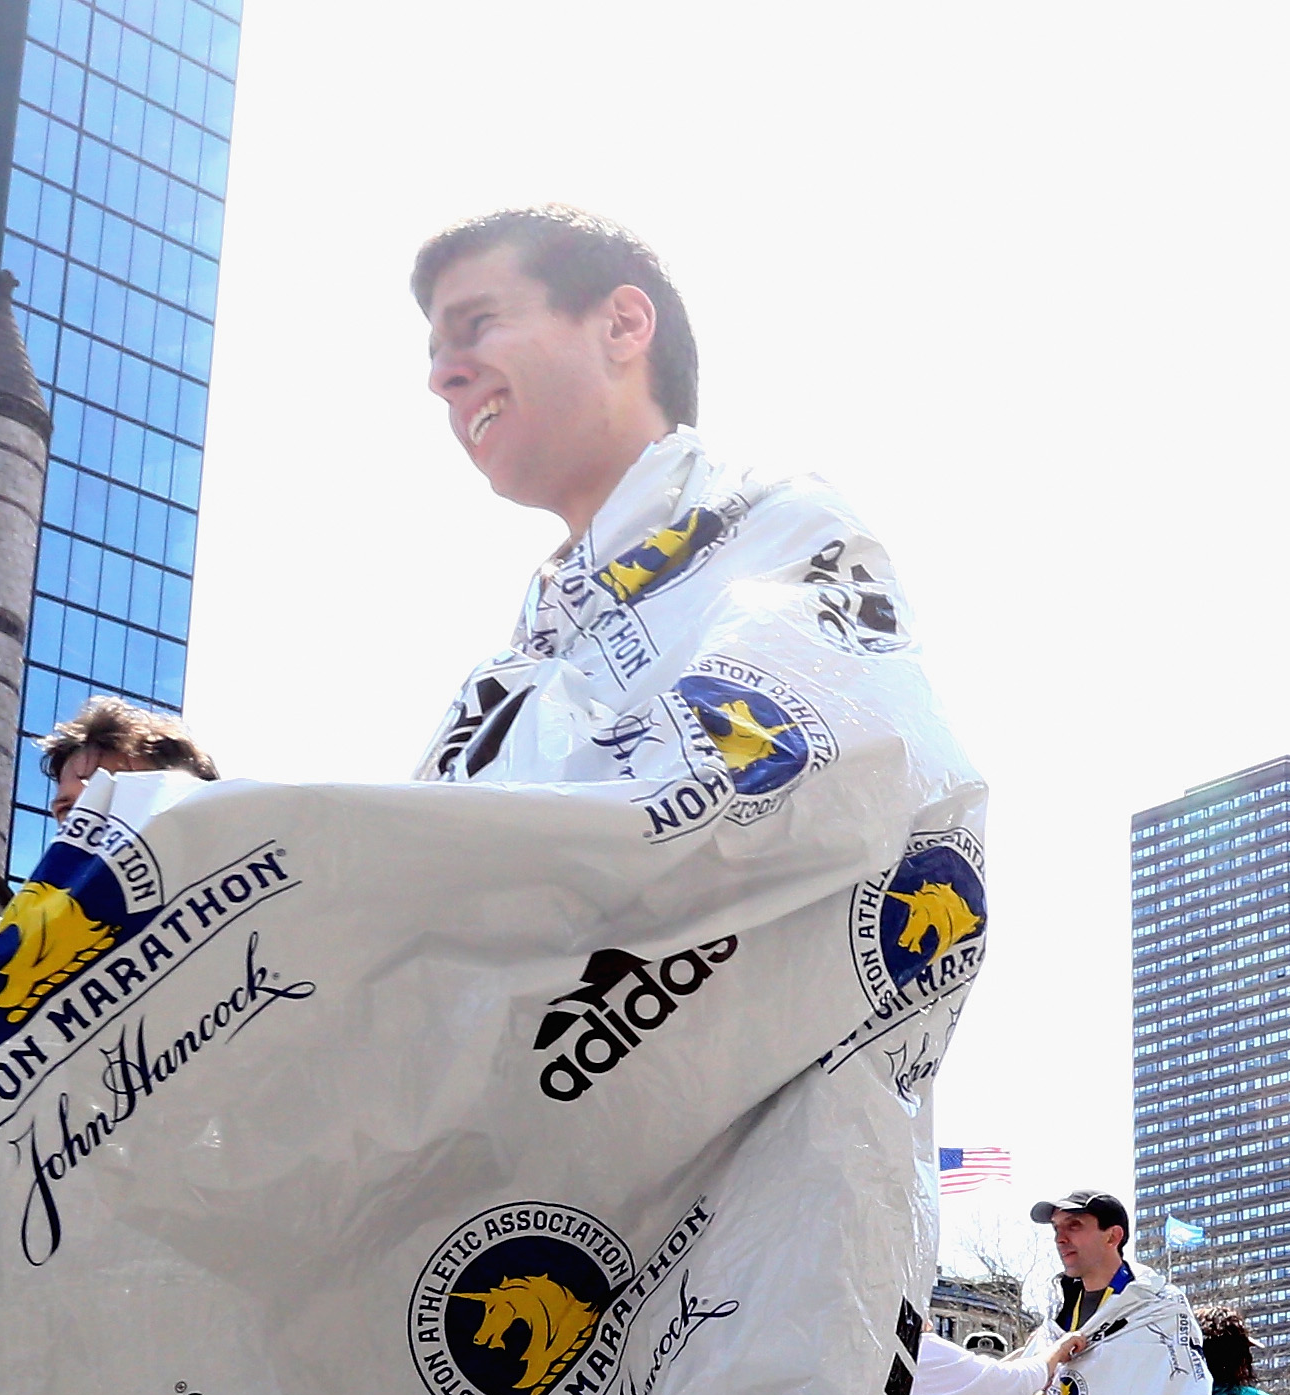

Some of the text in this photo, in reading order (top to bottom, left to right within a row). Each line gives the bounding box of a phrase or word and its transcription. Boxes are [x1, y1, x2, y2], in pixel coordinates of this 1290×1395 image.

[47, 853, 289, 1042] MARATHON
[9, 931, 316, 1266] John Hancock
[418, 1231, 482, 1343] ATHLETIC
[484, 1210, 629, 1287] ASSOCIATION
